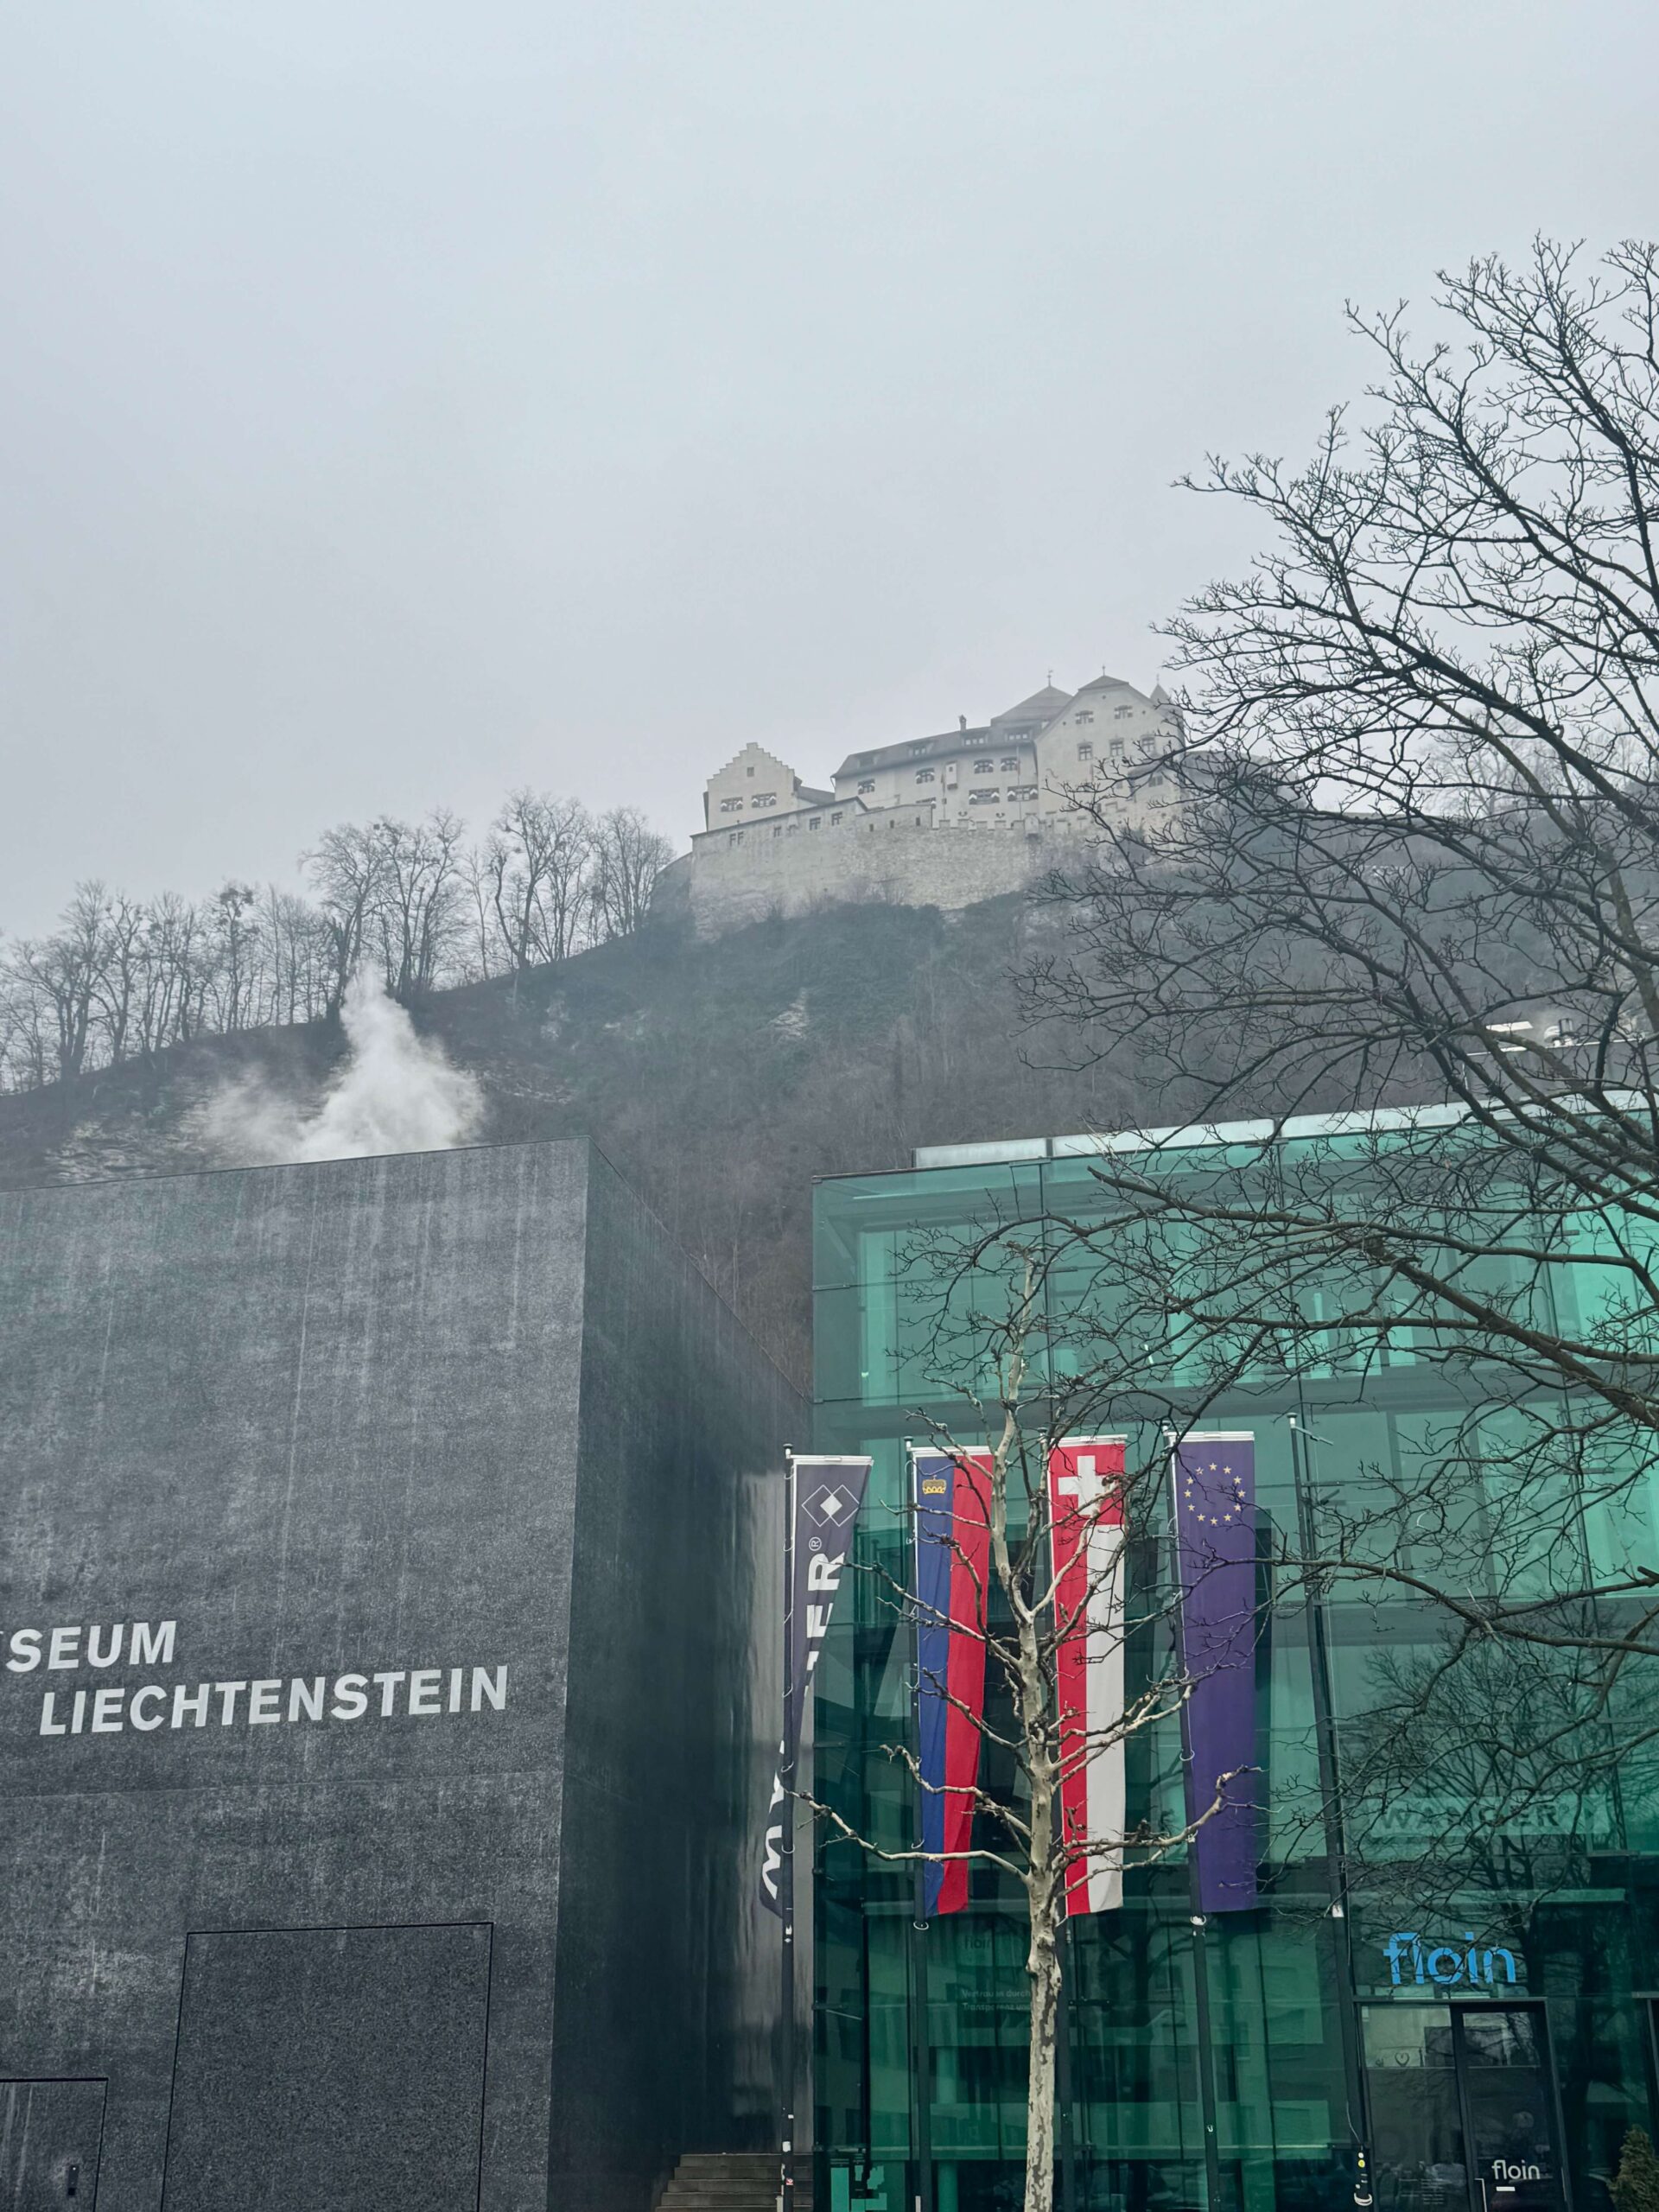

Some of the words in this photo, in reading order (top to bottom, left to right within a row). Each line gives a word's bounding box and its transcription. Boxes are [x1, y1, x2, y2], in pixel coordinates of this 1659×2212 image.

[0, 1620, 177, 1673] SEUM
[39, 1665, 509, 1736] LIECHTENSTEIN
[1383, 1931, 1516, 1985] floin
[1491, 2159, 1541, 2179] floin
